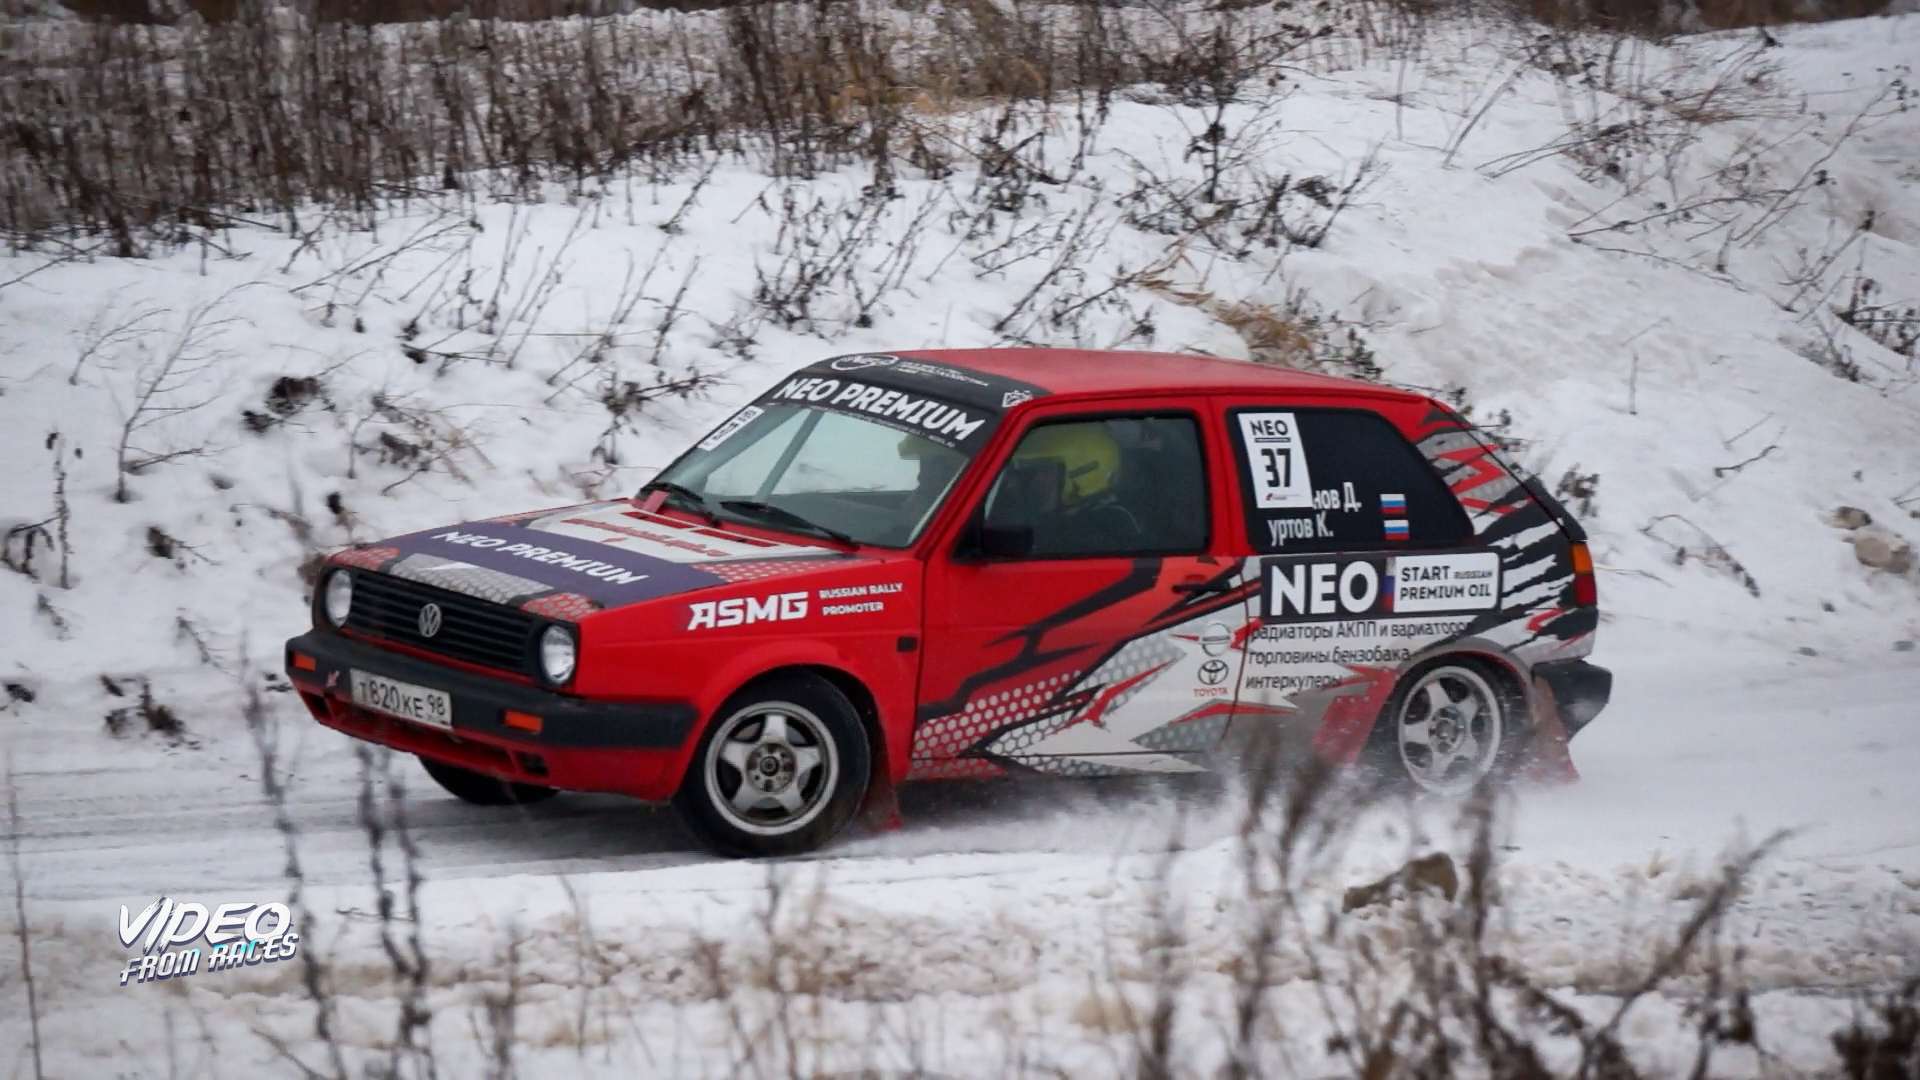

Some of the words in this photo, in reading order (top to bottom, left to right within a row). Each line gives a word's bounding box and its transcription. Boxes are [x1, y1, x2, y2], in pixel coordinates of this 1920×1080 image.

[773, 378, 840, 401] NEO
[830, 382, 986, 441] PREMIUM
[1251, 420, 1289, 436] NEO
[1261, 448, 1291, 488] 37
[1343, 482, 1362, 513] Д.
[1315, 511, 1334, 537] К.
[431, 531, 507, 549] NEO
[496, 543, 649, 585] PREMIUM
[1401, 565, 1451, 582] START
[1453, 570, 1493, 580] RUSSIAN
[819, 586, 867, 599] RUSSIAN
[869, 583, 903, 594] RALLY
[1270, 560, 1379, 616] NEO
[1400, 585, 1465, 600] PREMIUM
[1468, 583, 1492, 598] OIL
[687, 591, 808, 631] ASMG
[822, 602, 884, 616] PROMOTER
[1336, 621, 1377, 638] АКПП
[1380, 624, 1388, 637] и
[1249, 649, 1330, 667] горловины
[1332, 645, 1411, 663] бензобака
[1193, 687, 1228, 697] TOYOTA
